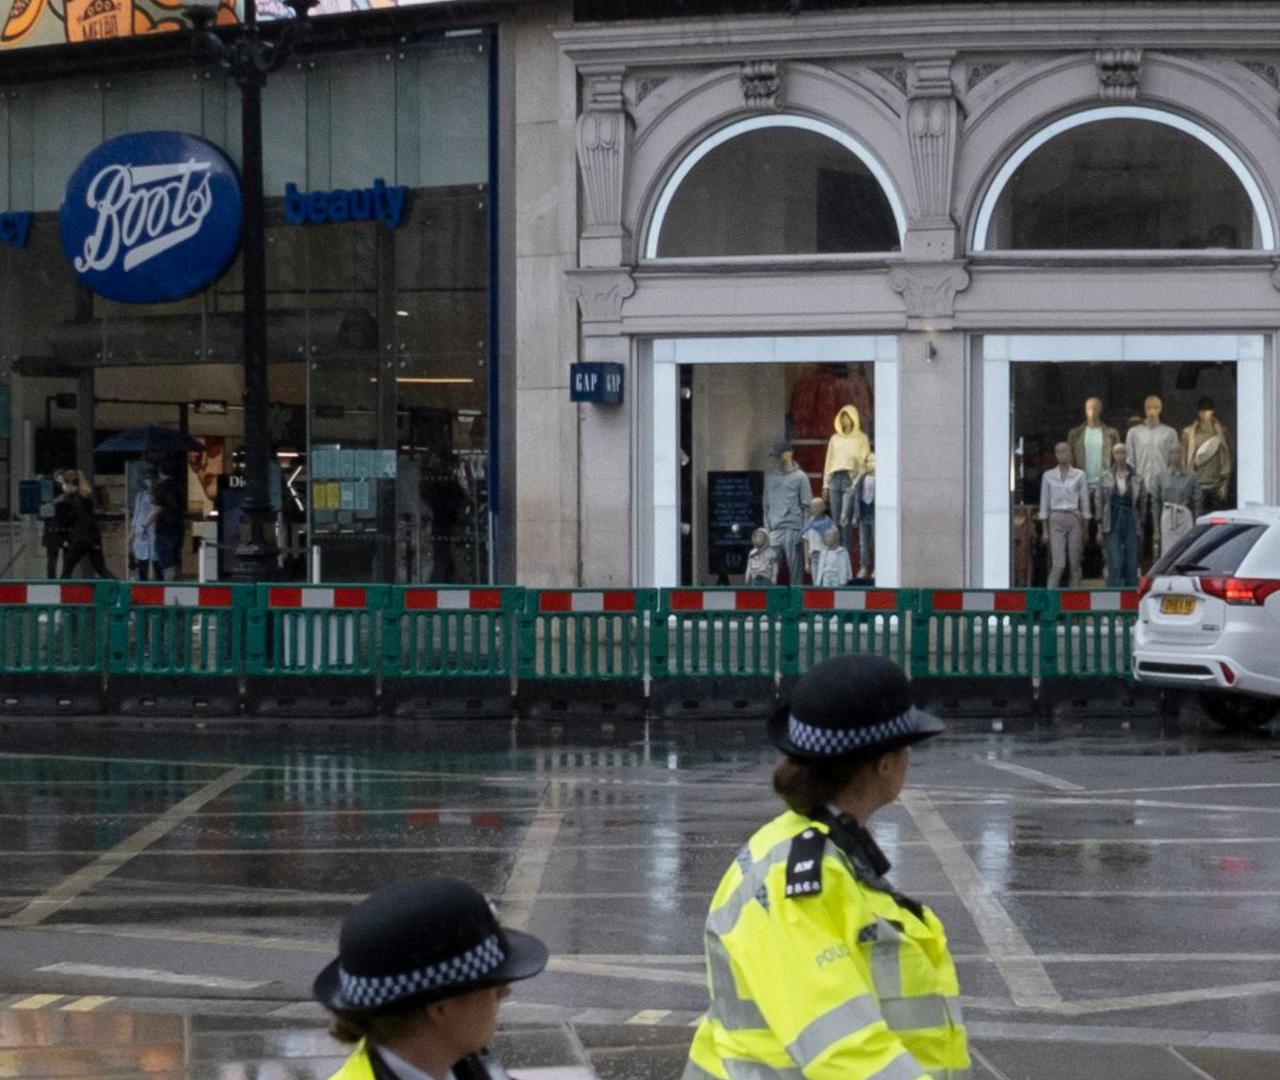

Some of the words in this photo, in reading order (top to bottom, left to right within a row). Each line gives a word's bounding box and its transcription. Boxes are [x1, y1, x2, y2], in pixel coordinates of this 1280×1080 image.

[74, 157, 213, 273] Boots
[285, 177, 409, 231] beauty
[575, 373, 597, 392] GAP
